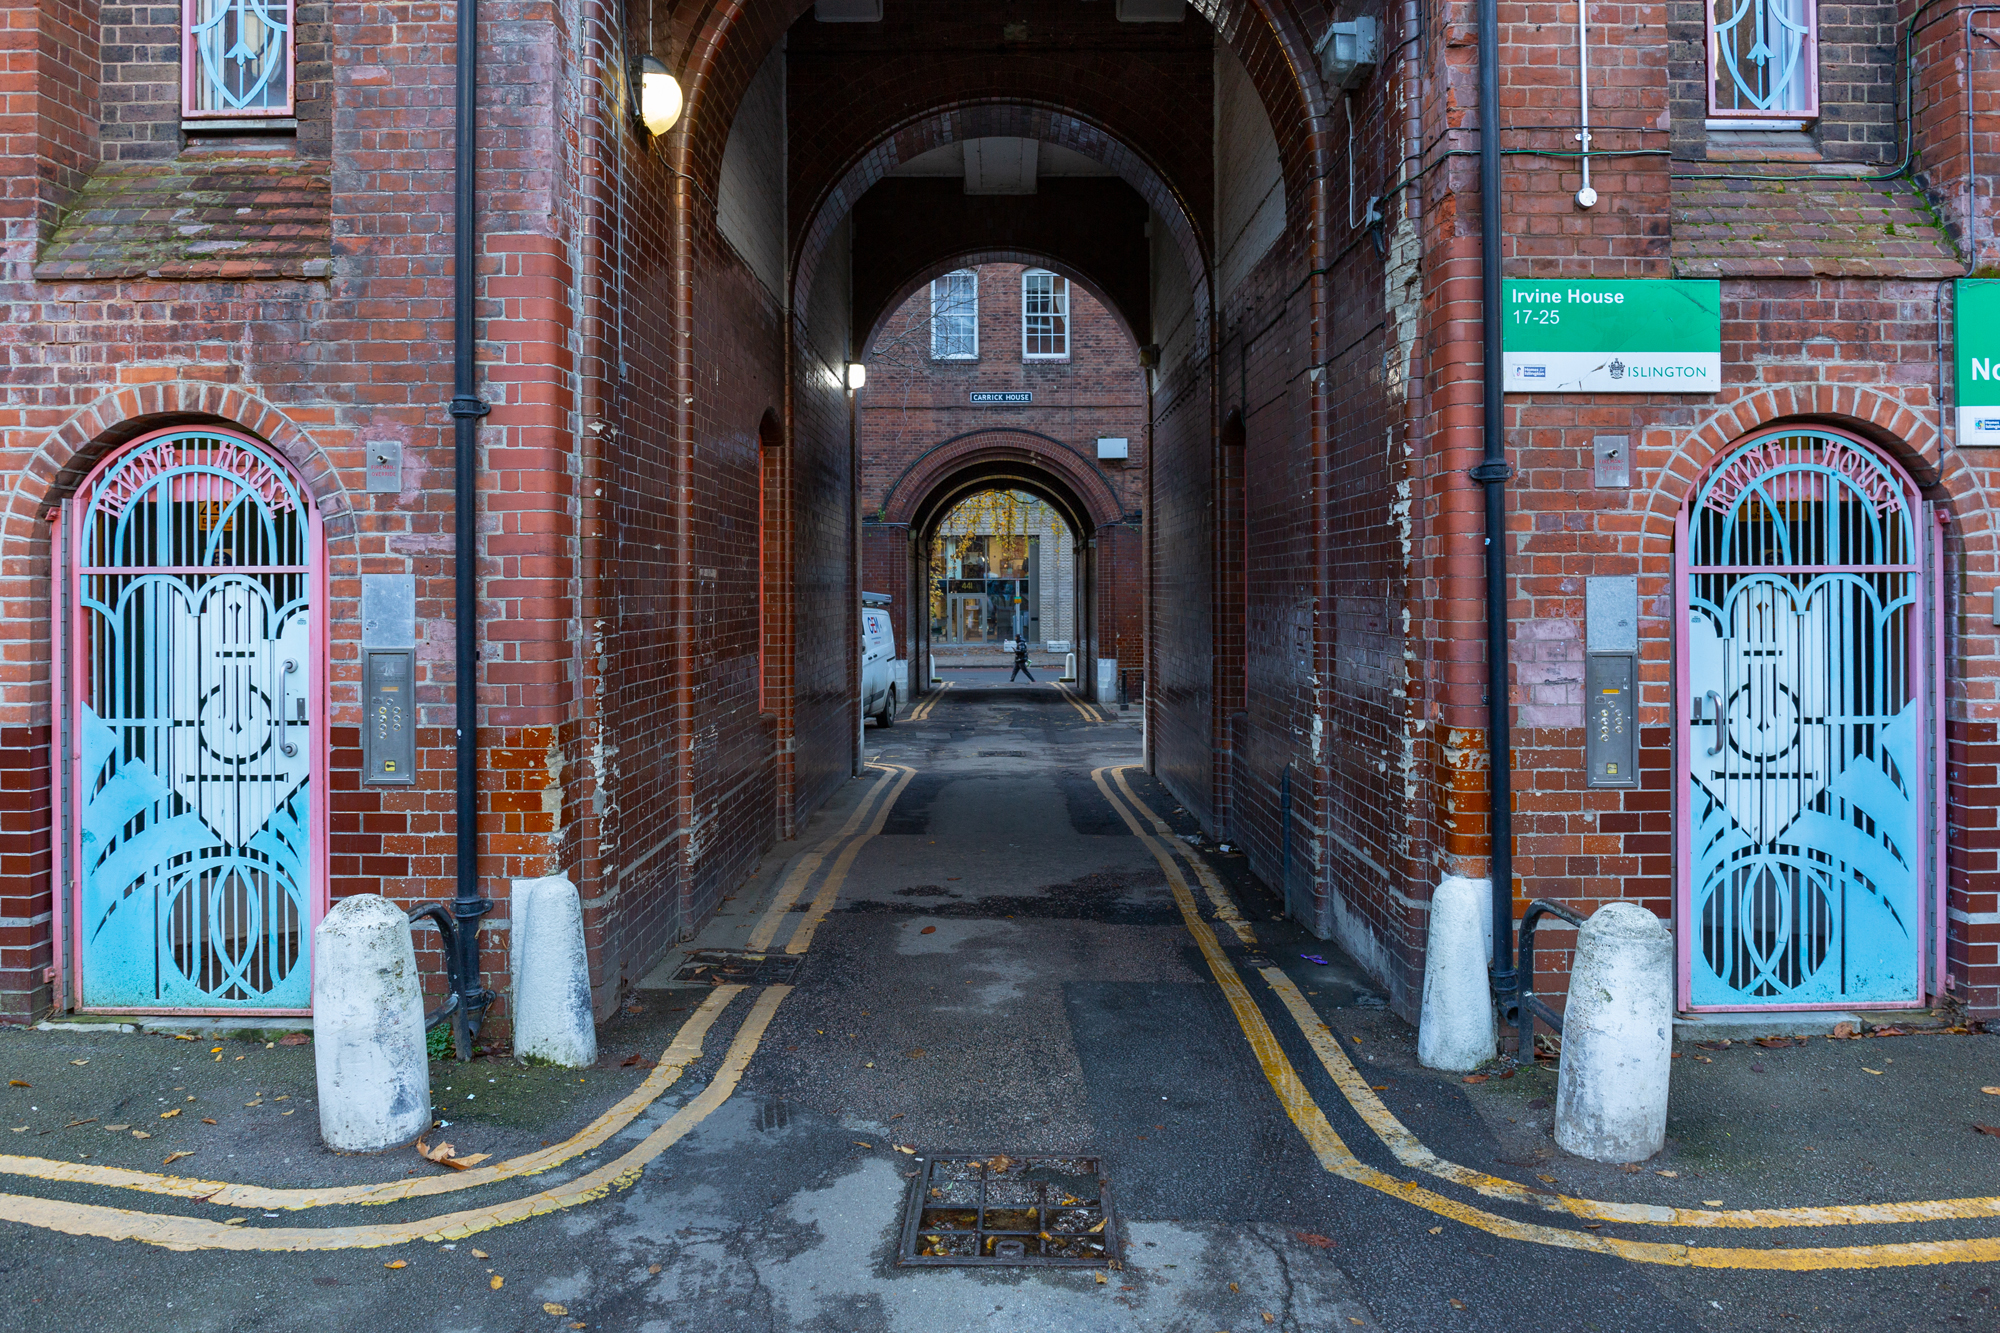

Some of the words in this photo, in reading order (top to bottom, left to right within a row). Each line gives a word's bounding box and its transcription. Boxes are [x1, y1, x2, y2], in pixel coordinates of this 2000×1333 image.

[1512, 288, 1562, 304] Irvine
[1567, 288, 1625, 304] House
[1512, 309, 1560, 325] 17-25
[1627, 366, 1707, 378] ISLINGTON
[95, 440, 179, 520] IRVINE
[213, 440, 296, 520] HOUSE
[1703, 438, 1786, 518] IRVINE
[1820, 439, 1902, 520] HOUSE
[961, 582, 973, 590] 441
[867, 616, 881, 634] GEM
